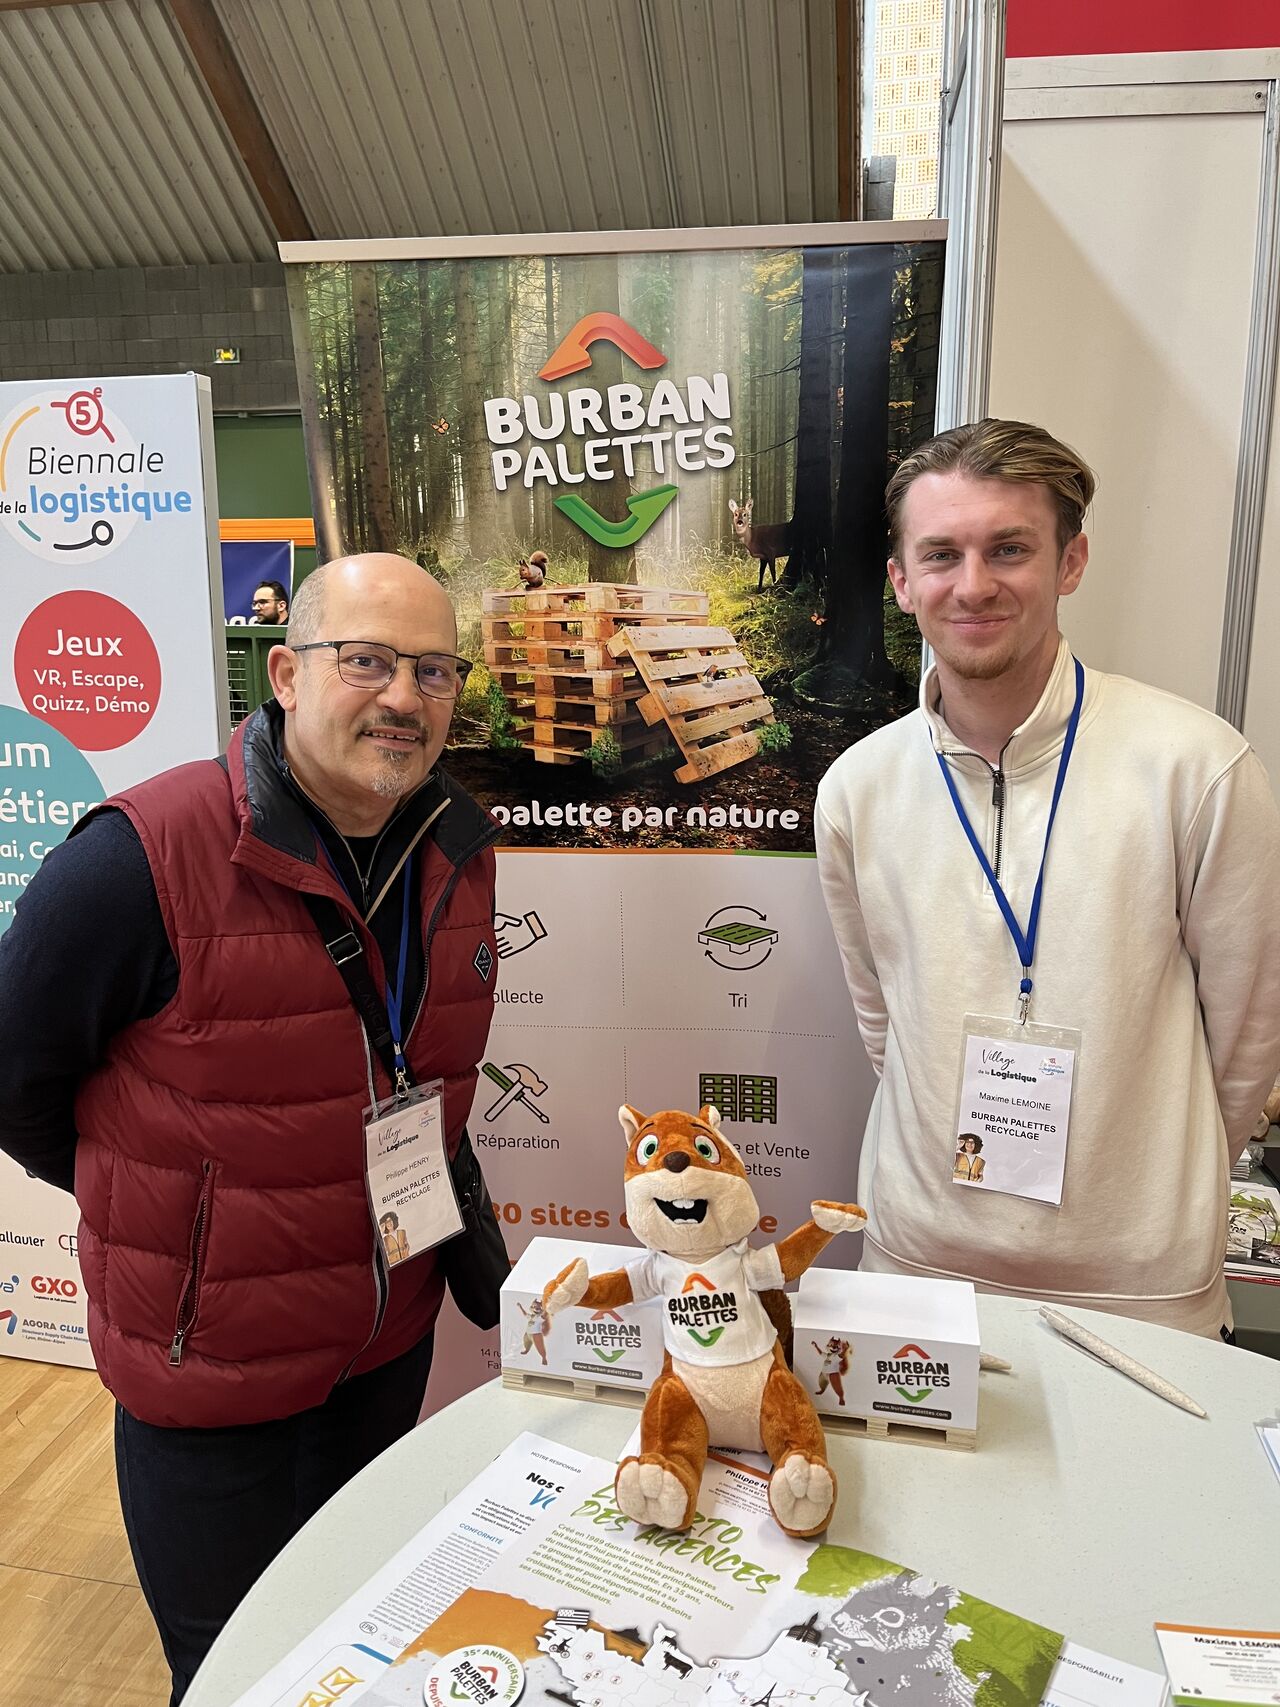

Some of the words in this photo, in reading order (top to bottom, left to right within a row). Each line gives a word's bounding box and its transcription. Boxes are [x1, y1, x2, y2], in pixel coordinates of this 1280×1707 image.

[484, 373, 731, 444] BURBAN
[28, 443, 164, 475] Biennale
[491, 425, 735, 491] PALETTES
[15, 500, 27, 514] la
[30, 483, 192, 523] logistique
[48, 629, 123, 657] Jeux
[33, 669, 67, 688] VR,
[72, 670, 145, 692] Escape,
[33, 695, 91, 714] Quizz,
[96, 694, 151, 714] Démo
[0, 788, 101, 825] étier
[621, 804, 678, 832] par
[686, 803, 800, 830] nature
[493, 989, 544, 1004] ollecte
[728, 992, 748, 1007] Tri
[981, 1049, 1016, 1070] Village
[990, 1068, 1037, 1083] Logistique
[979, 1091, 1010, 1106] Maxime
[1011, 1096, 1051, 1111] LEMOINE
[971, 1111, 1009, 1125] BURBAN
[1010, 1118, 1056, 1133] PALETTES
[985, 1124, 1040, 1141] RECYCLAGE
[378, 1127, 402, 1147] Village
[386, 1133, 419, 1153] Logistique
[476, 1133, 560, 1150] Réparation
[745, 1143, 762, 1156] et
[763, 1142, 811, 1159] Vente
[385, 1165, 409, 1182] Philippe
[408, 1155, 430, 1172] HENRY
[745, 1162, 782, 1178] ettes
[382, 1185, 409, 1204] BURBAN
[409, 1170, 441, 1192] PALETTES
[396, 1184, 431, 1207] RECYCLAGE
[530, 1202, 610, 1228] sites
[31, 1275, 78, 1297] GXO
[667, 1291, 737, 1312] BURBAN
[23, 1319, 57, 1331] AGORA
[60, 1324, 84, 1334] CLUB
[669, 1306, 739, 1326] PALETTES
[575, 1322, 641, 1337] BURBAN
[576, 1335, 642, 1348] PALETTES
[876, 1360, 949, 1375] BURBAN
[877, 1374, 950, 1387] PALETTES
[875, 1403, 949, 1417] www.burban-palettes.com
[531, 1450, 548, 1462] NOTRE
[549, 1457, 582, 1474] RESPONSAB
[526, 1471, 555, 1489] Nos
[725, 1469, 760, 1487] Philippe
[570, 1500, 630, 1532] DES
[459, 1522, 503, 1545] CONFORMITÉ
[558, 1523, 574, 1533] Créé
[586, 1534, 605, 1545] 1989
[604, 1541, 622, 1552] dans
[623, 1548, 631, 1556] le
[631, 1551, 654, 1565] Loiret,
[656, 1561, 684, 1577] Burban
[684, 1572, 717, 1590] Palettes
[633, 1525, 781, 1595] AGENCES
[526, 1557, 563, 1576] croissants,
[574, 1575, 592, 1586] plus
[591, 1582, 609, 1594] près
[609, 1590, 620, 1598] de
[545, 1536, 555, 1544] du
[555, 1540, 583, 1554] marché
[583, 1551, 612, 1567] français
[612, 1562, 623, 1570] de
[630, 1570, 660, 1586] palette.
[662, 1582, 673, 1591] En
[673, 1587, 686, 1597] 35
[684, 1593, 701, 1605] ans,
[547, 1546, 575, 1561] groupe
[575, 1556, 603, 1572] familial
[603, 1568, 611, 1576] et
[611, 1571, 662, 1596] indépendant
[668, 1595, 678, 1603] su
[551, 1529, 564, 1539] fait
[605, 1551, 629, 1564] partie
[629, 1560, 643, 1570] des
[644, 1565, 661, 1576] trois
[661, 1574, 704, 1595] principaux
[704, 1591, 734, 1611] acteurs
[518, 1563, 532, 1572] ses
[531, 1567, 556, 1582] clients
[556, 1577, 565, 1586] et
[564, 1579, 613, 1605] fournisseurs.
[541, 1552, 584, 1574] développer
[583, 1570, 602, 1581] pour
[602, 1577, 640, 1596] répondre
[645, 1596, 661, 1605] des
[660, 1601, 693, 1621] besoins
[459, 1660, 499, 1700] BURBAN
[482, 1649, 519, 1701] ANNIVERSAIRE
[1057, 1655, 1124, 1684] RESPONSABILITÉ
[450, 1667, 489, 1706] PALETTES
